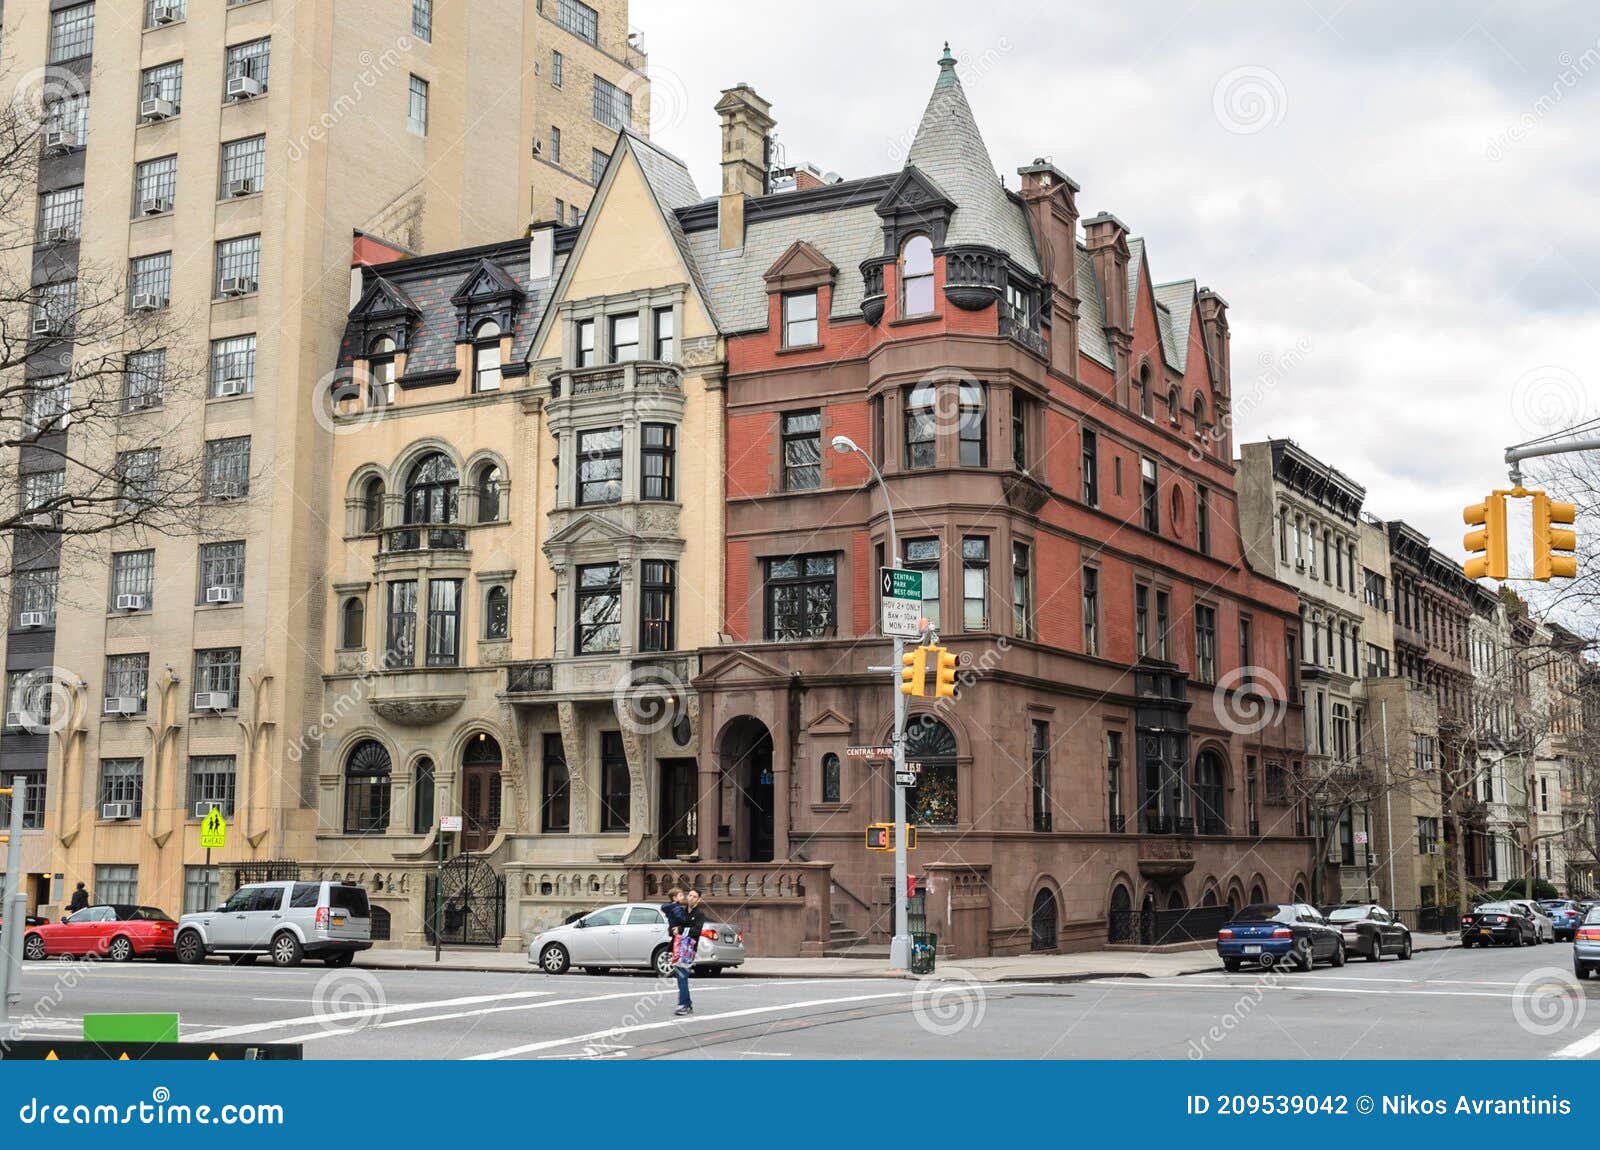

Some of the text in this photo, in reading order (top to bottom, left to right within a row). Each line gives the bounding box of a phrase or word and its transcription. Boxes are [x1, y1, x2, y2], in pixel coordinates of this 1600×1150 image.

[894, 573, 915, 582] CENTRAL
[884, 601, 895, 609] HOV
[889, 622, 902, 630] MON
[907, 623, 916, 632] FRI
[847, 747, 893, 756] CENTRAL PARK
[203, 837, 223, 845] AHEAD
